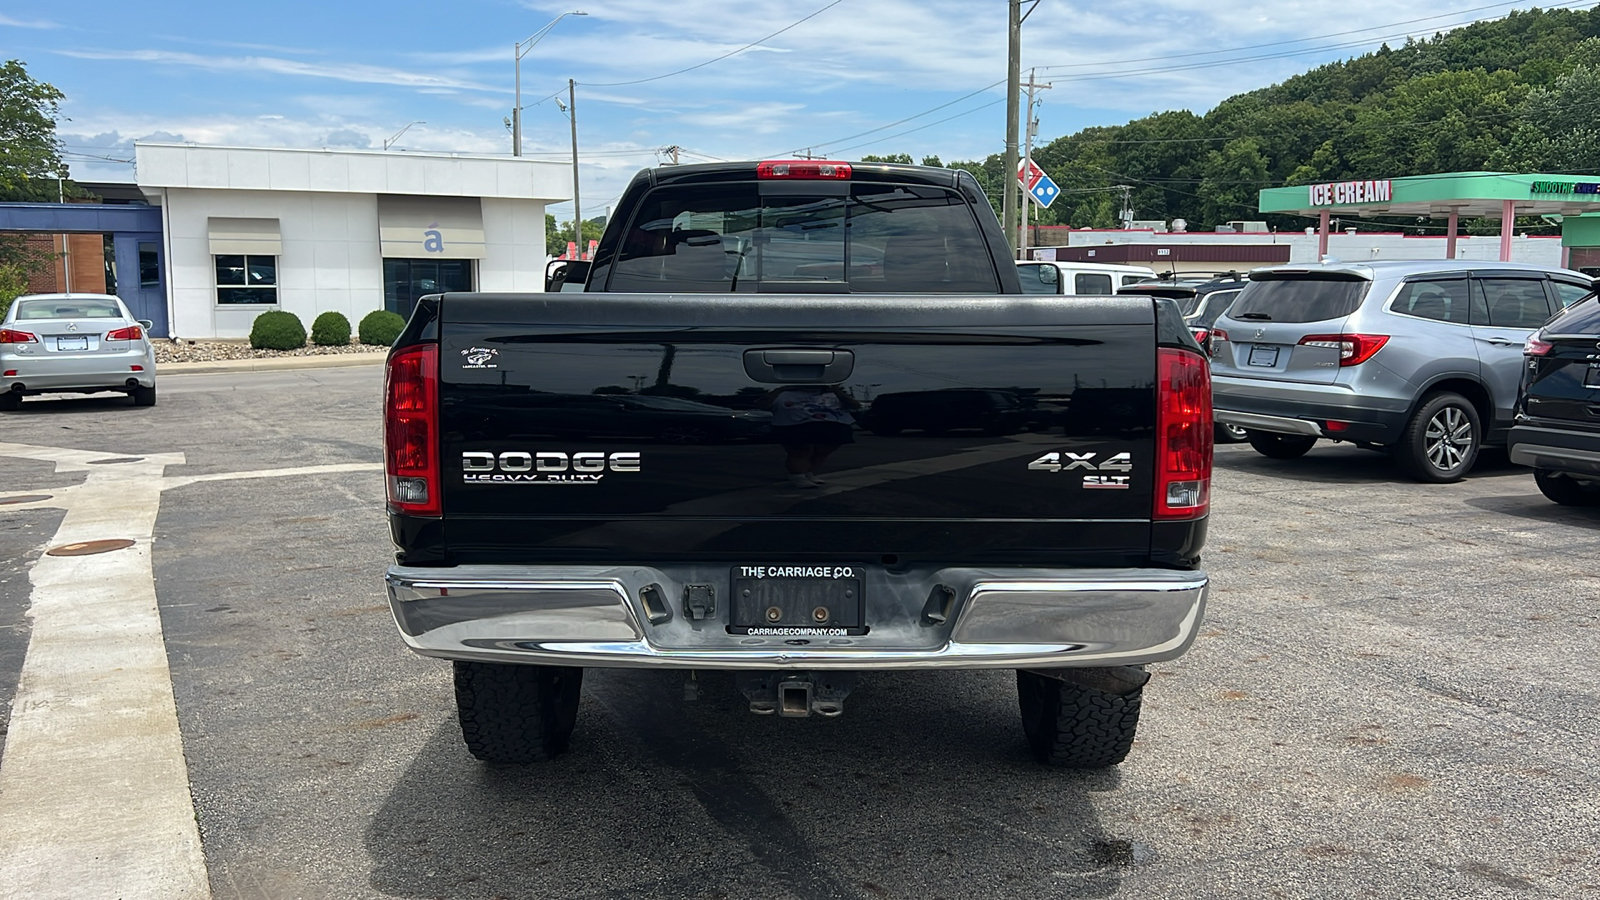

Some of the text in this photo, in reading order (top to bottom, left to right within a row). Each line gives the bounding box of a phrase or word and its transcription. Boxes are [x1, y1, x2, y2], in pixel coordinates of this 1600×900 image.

[1309, 180, 1392, 206] ICE CREAM
[424, 221, 444, 253] á
[462, 451, 641, 472] DODGE
[463, 474, 604, 482] HEAVY DUTY
[1083, 475, 1130, 486] SLT
[740, 566, 856, 578] THE CARRIAGE CO.
[747, 627, 848, 637] CARRIAGECOMPANY.COM
